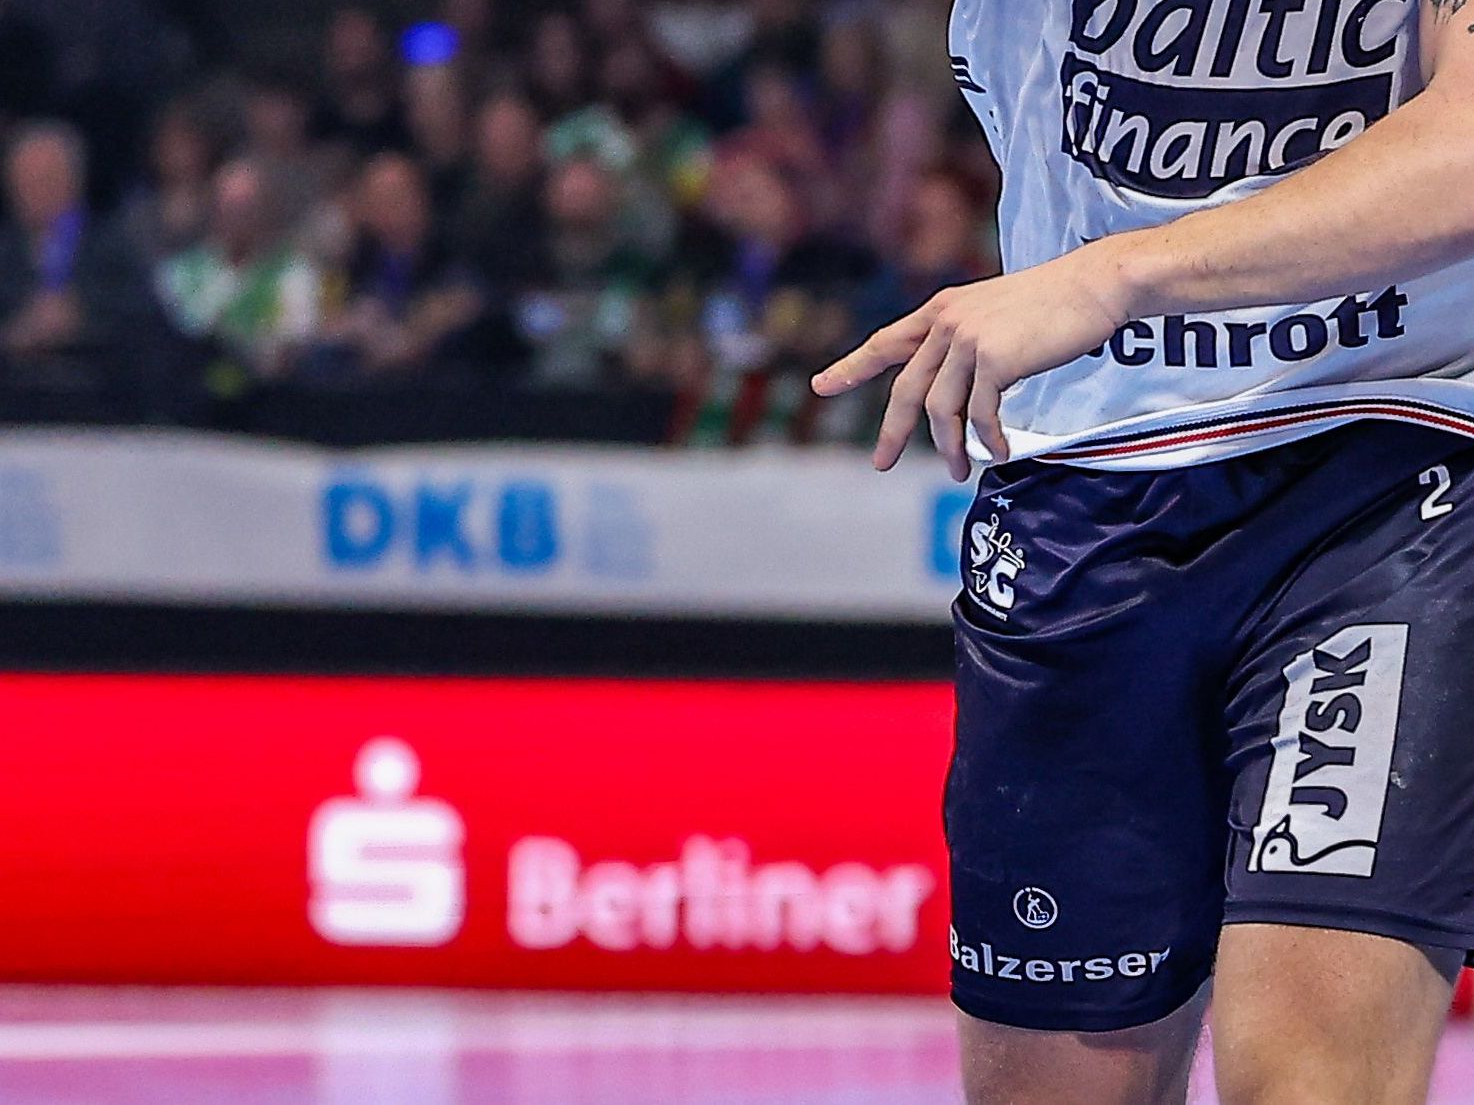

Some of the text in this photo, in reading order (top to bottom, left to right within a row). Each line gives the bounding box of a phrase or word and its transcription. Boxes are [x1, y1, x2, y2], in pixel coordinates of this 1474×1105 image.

[1086, 284, 1408, 368] chrott
[322, 479, 562, 571] DKB
[1418, 463, 1453, 520] 2
[1289, 637, 1372, 821] JYSK
[507, 836, 932, 952] Berliner
